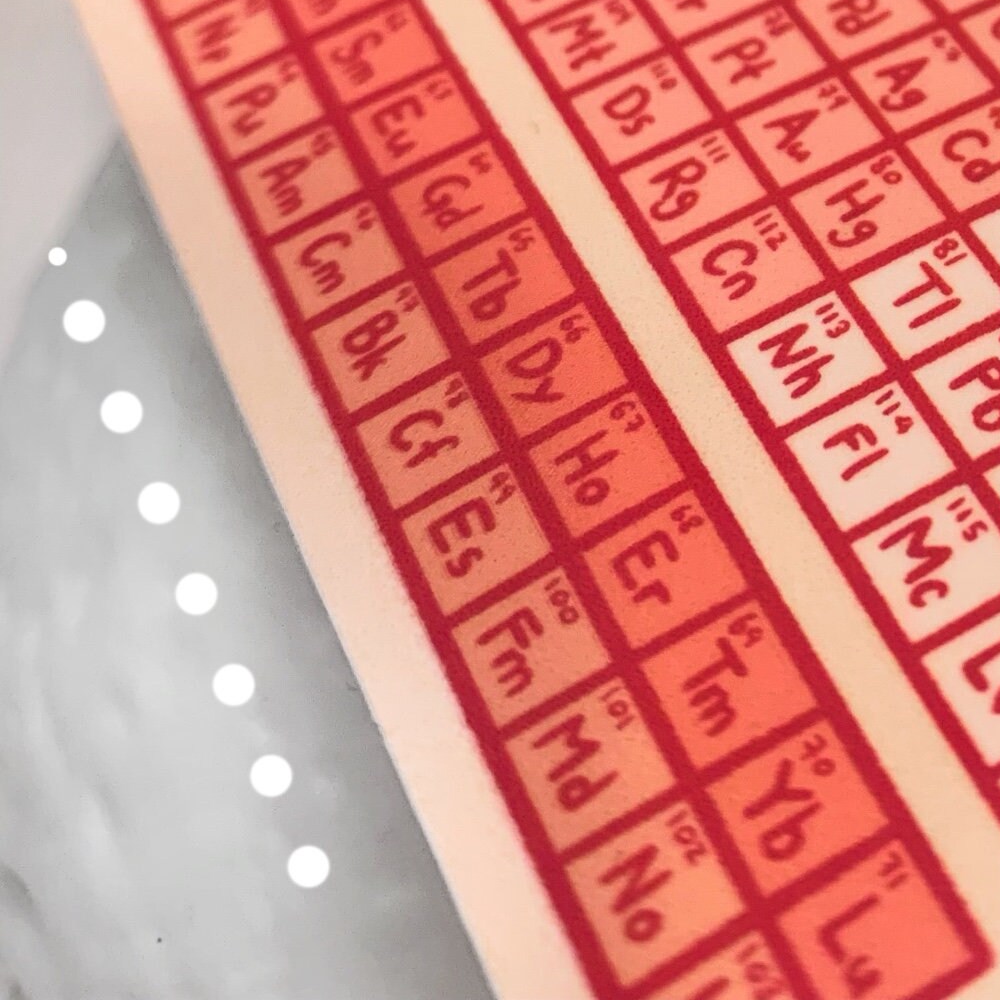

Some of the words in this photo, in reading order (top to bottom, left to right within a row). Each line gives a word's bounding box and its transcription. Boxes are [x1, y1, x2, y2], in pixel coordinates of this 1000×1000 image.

[329, 31, 384, 85] Sm
[547, 14, 616, 71] Mt
[711, 37, 775, 85] Pt
[601, 84, 655, 137] Ds
[875, 57, 929, 113] Ag
[369, 94, 426, 159] Eu
[701, 135, 729, 164] 111
[763, 109, 821, 163] Au
[259, 155, 313, 217] Am
[649, 156, 707, 223] Rg
[869, 155, 903, 185] 80
[421, 173, 485, 233] Gd
[753, 213, 788, 252] 112
[824, 178, 885, 249] Hg
[298, 231, 353, 295] Cm
[507, 227, 535, 253] 65
[701, 239, 759, 301] Cn
[933, 237, 968, 267] 81
[461, 247, 522, 323] Tb
[892, 261, 962, 330] Tl
[341, 309, 407, 382] Bk
[559, 313, 591, 345] 66
[815, 301, 851, 339] 113
[504, 336, 565, 405] Dy
[757, 323, 835, 400] Nh
[387, 409, 460, 469] Cf
[609, 400, 646, 433] 67
[489, 471, 518, 505] 99
[553, 429, 621, 507] Ho
[425, 495, 497, 579] Es
[669, 503, 705, 535] 68
[946, 497, 989, 543] 115
[609, 529, 680, 605] Er
[878, 515, 953, 609] Mc
[543, 577, 581, 625] 100
[727, 612, 764, 649] 69
[475, 606, 545, 698] Fm
[600, 686, 635, 731] 101
[681, 637, 749, 738] Tm
[531, 713, 619, 813] Md
[667, 811, 708, 865] 102
[741, 757, 823, 863] Yb
[597, 843, 673, 943] No
[878, 851, 909, 889] 71
[817, 893, 882, 1000] Lu
